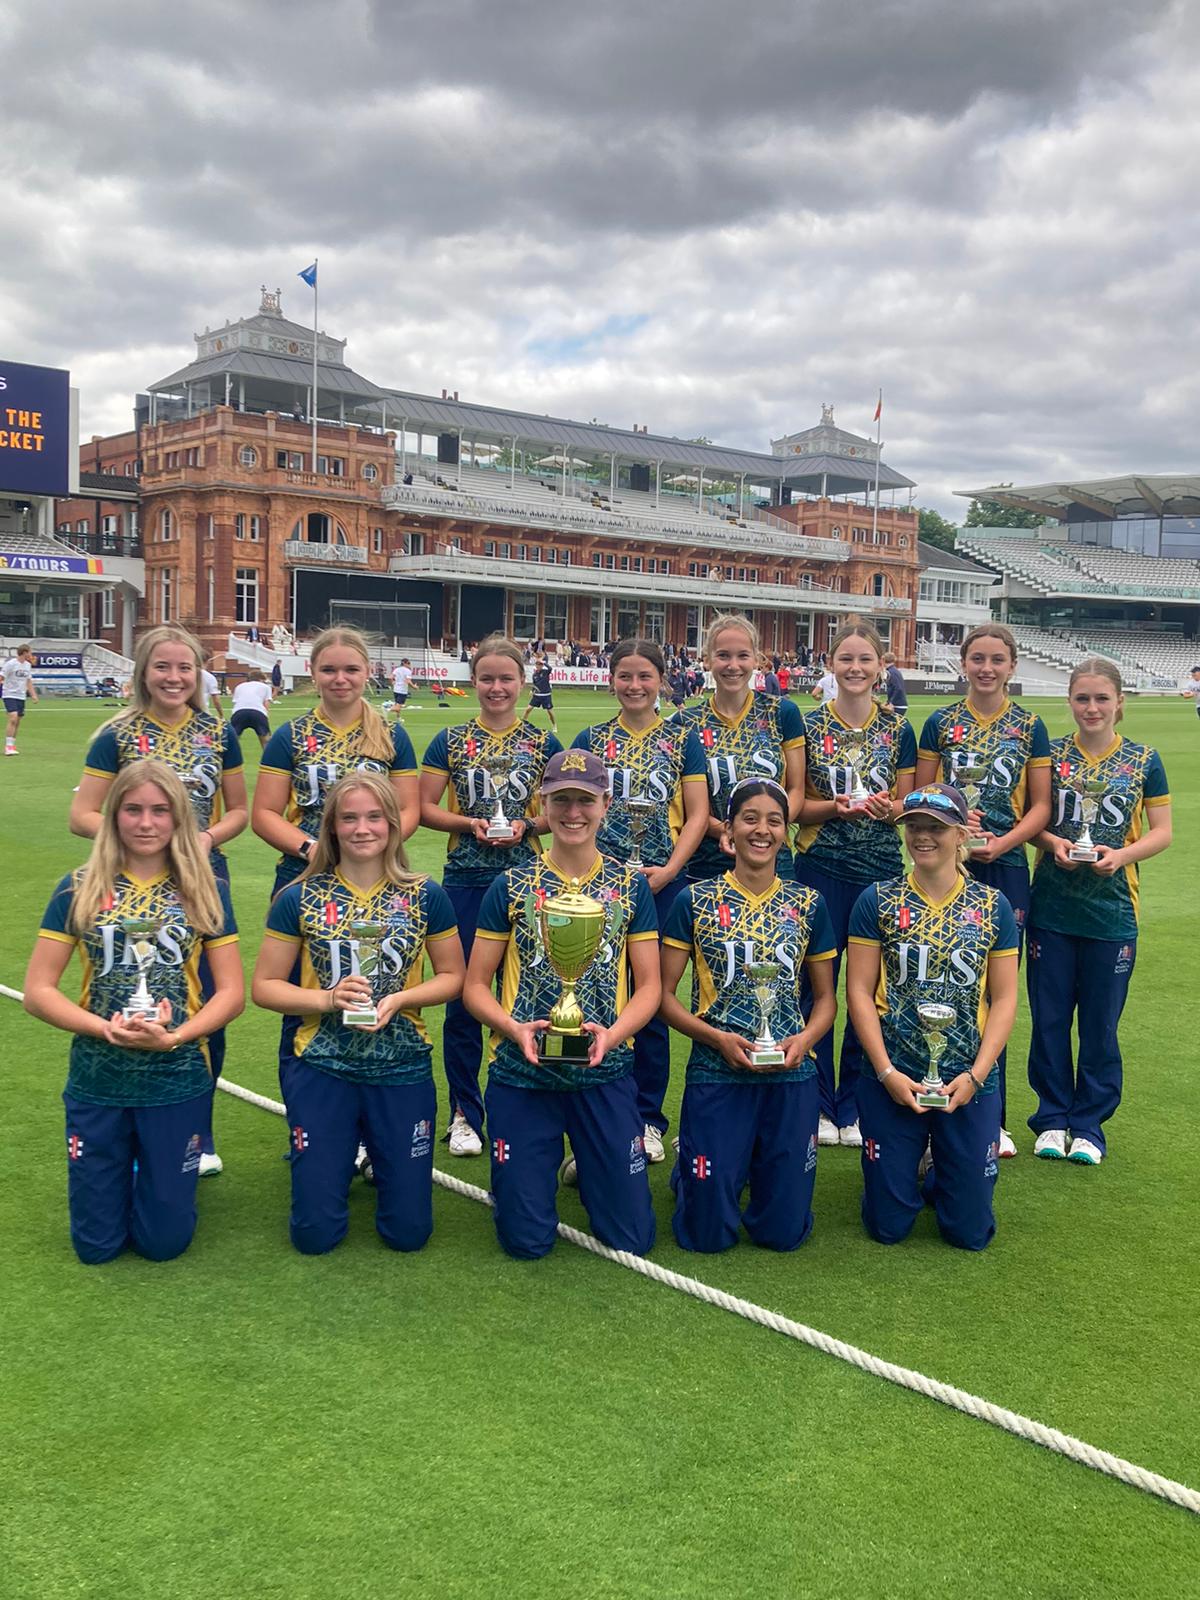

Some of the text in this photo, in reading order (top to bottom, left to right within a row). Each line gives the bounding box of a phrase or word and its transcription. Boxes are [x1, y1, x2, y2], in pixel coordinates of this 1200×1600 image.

[6, 408, 42, 429] THE
[40, 656, 79, 666] LORD'S
[570, 670, 577, 682] &
[580, 670, 599, 683] Life
[895, 942, 979, 987] JLS
